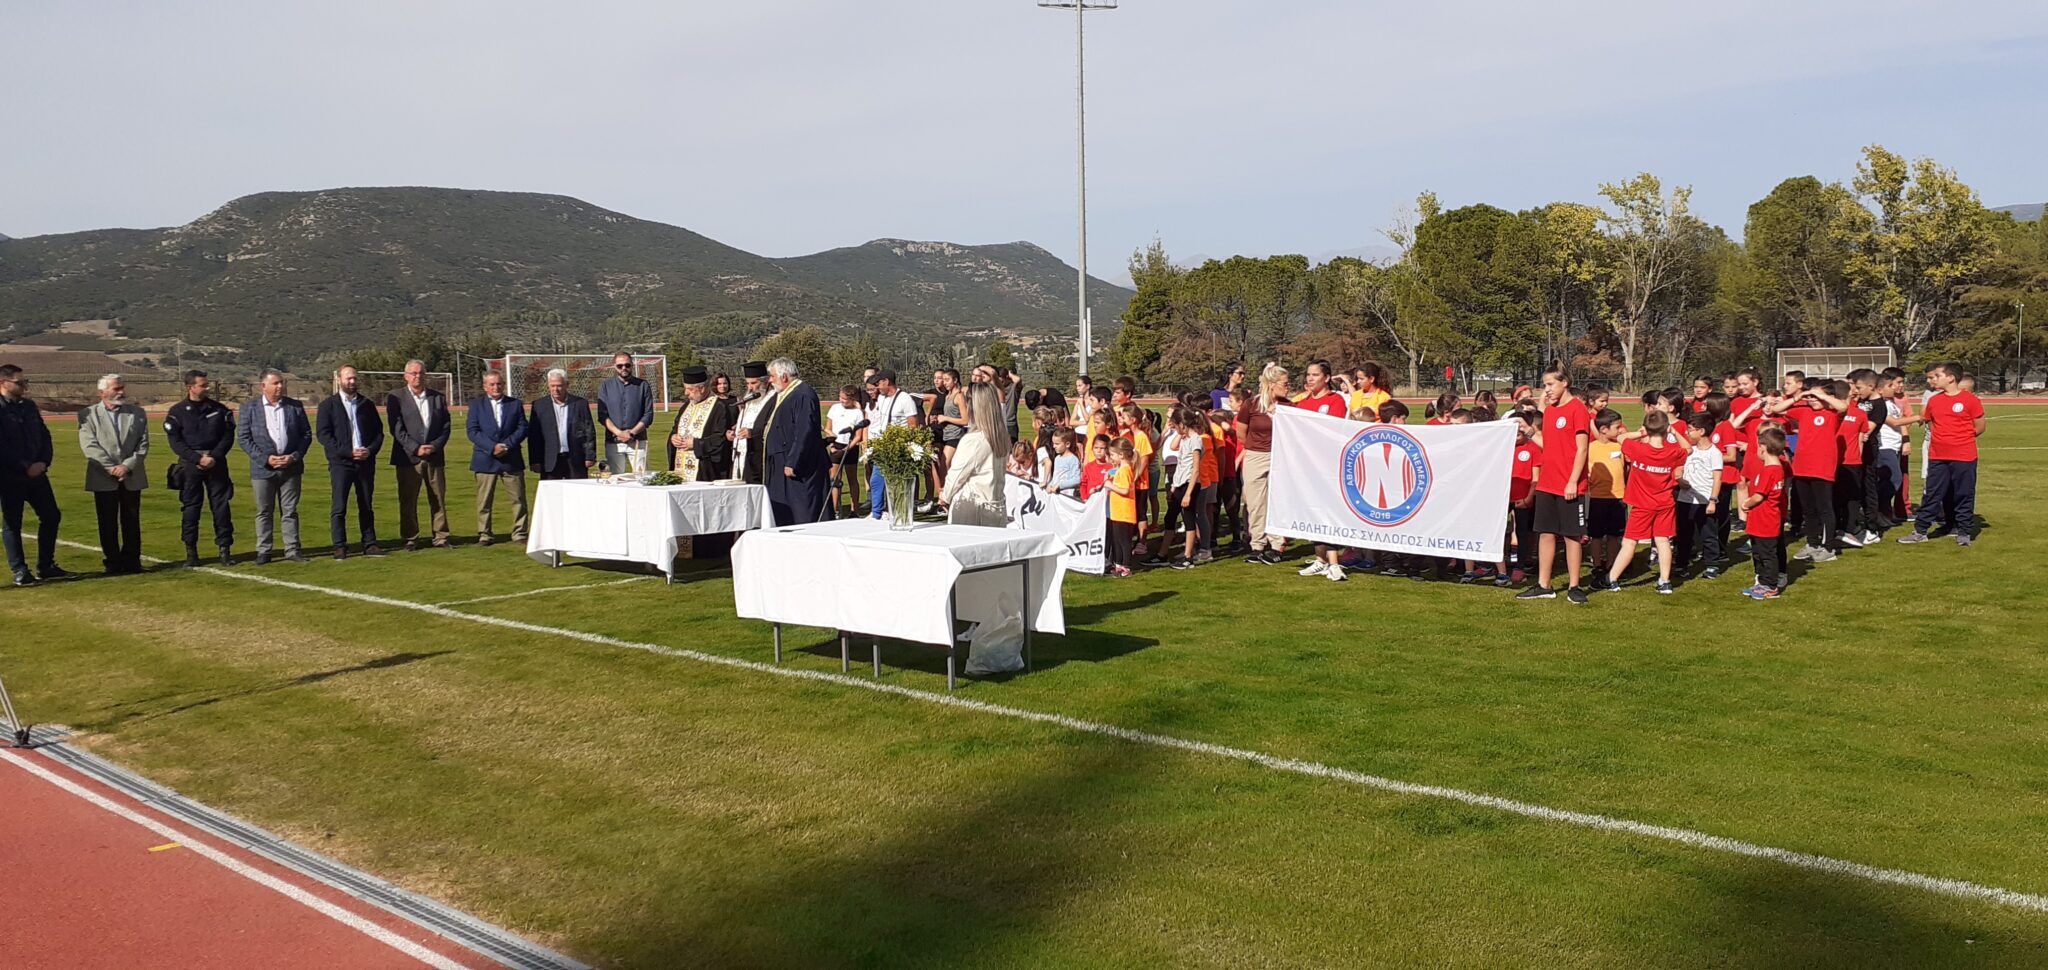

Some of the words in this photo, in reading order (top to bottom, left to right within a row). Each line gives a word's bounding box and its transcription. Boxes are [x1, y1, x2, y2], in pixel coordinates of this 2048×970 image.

[1346, 439, 1368, 486] ΑΘΛΗΤΙΚΟΣ
[1369, 433, 1414, 451] ΣΥΛΛΟΓΟΣ
[1411, 452, 1425, 492] ΝΕΜΕΑΣ
[1369, 510, 1391, 519] 2016
[1290, 520, 1358, 539] ΑΘΛΗΤΙΚΟΣ
[1360, 530, 1424, 547] ΣΥΛΛΟΓΟΣ
[1427, 538, 1484, 553] ΝΕΜΕΑΣ
